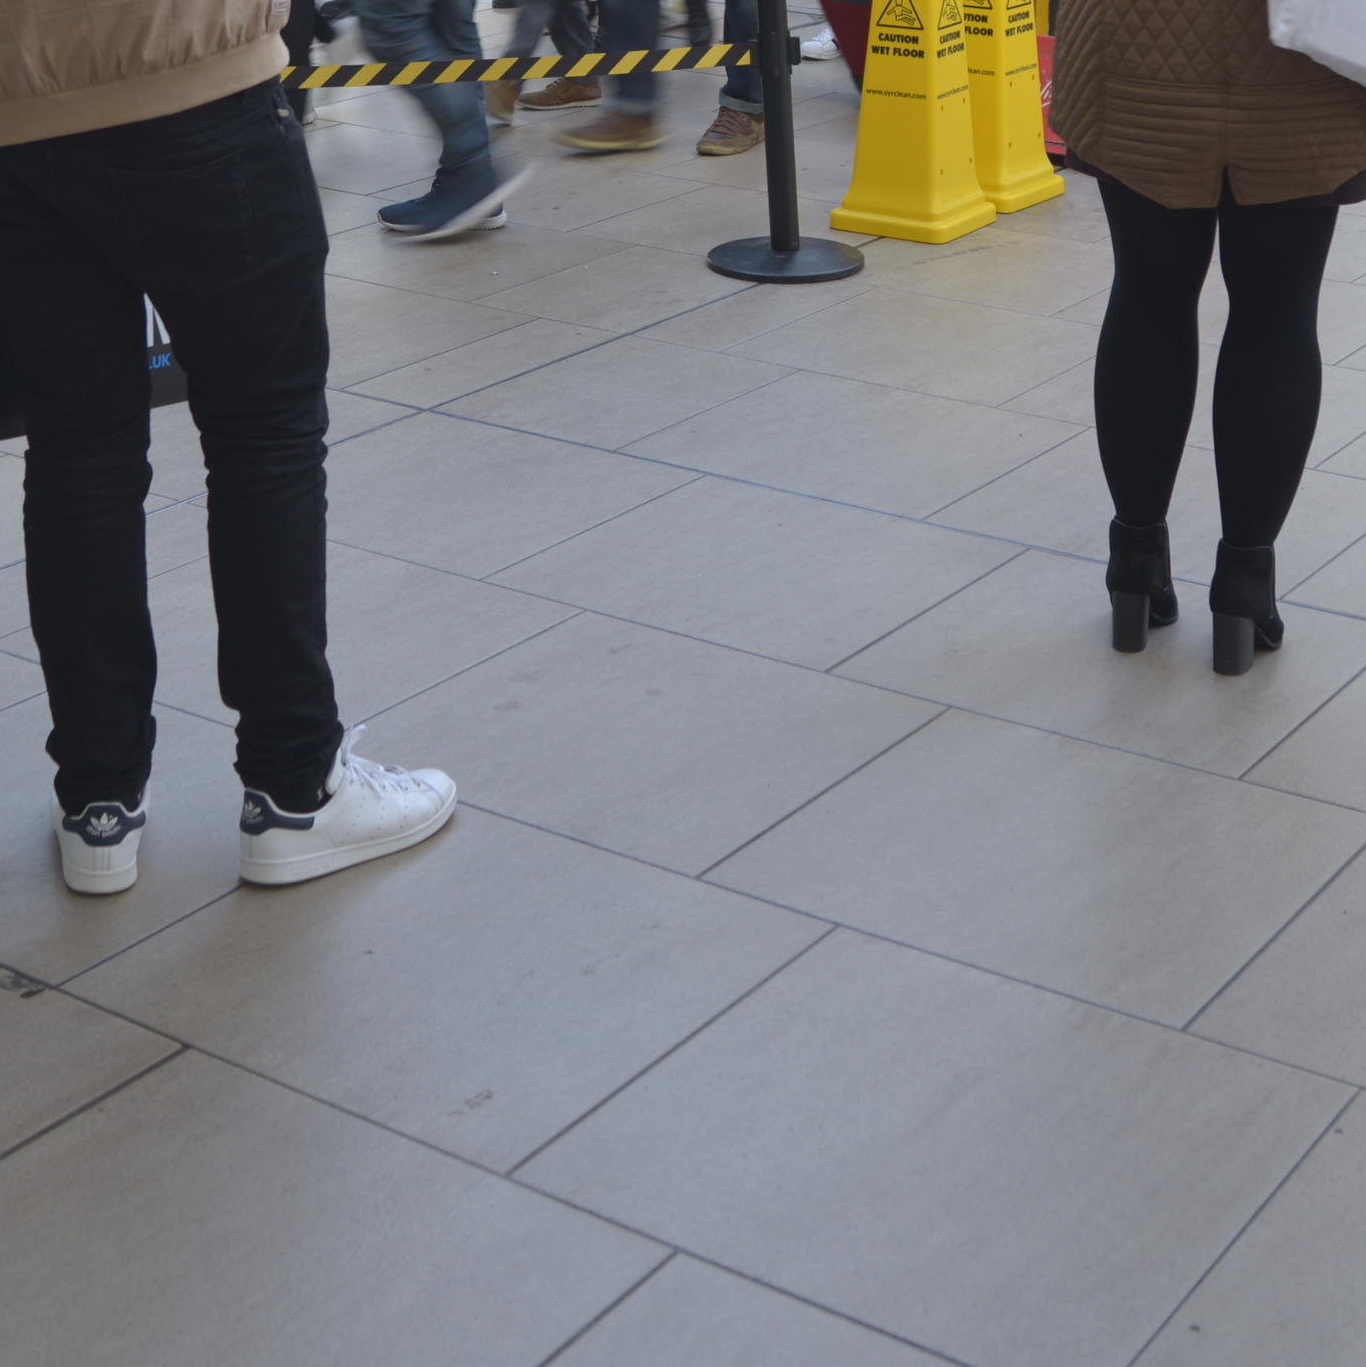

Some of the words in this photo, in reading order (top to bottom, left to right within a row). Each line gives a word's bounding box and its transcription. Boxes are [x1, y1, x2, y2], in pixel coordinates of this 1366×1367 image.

[1008, 11, 1030, 24] CAUTION
[964, 26, 994, 37] FLOOR
[1005, 27, 1016, 37] WET
[1016, 22, 1034, 34] FLOOR
[878, 32, 919, 45] CAUTION
[939, 30, 961, 44] CAUTION
[871, 45, 891, 56] WET
[893, 46, 925, 59] FLOOR
[937, 48, 947, 59] WET
[948, 42, 965, 55] FLOOR
[866, 88, 927, 100] www.syrclean.com
